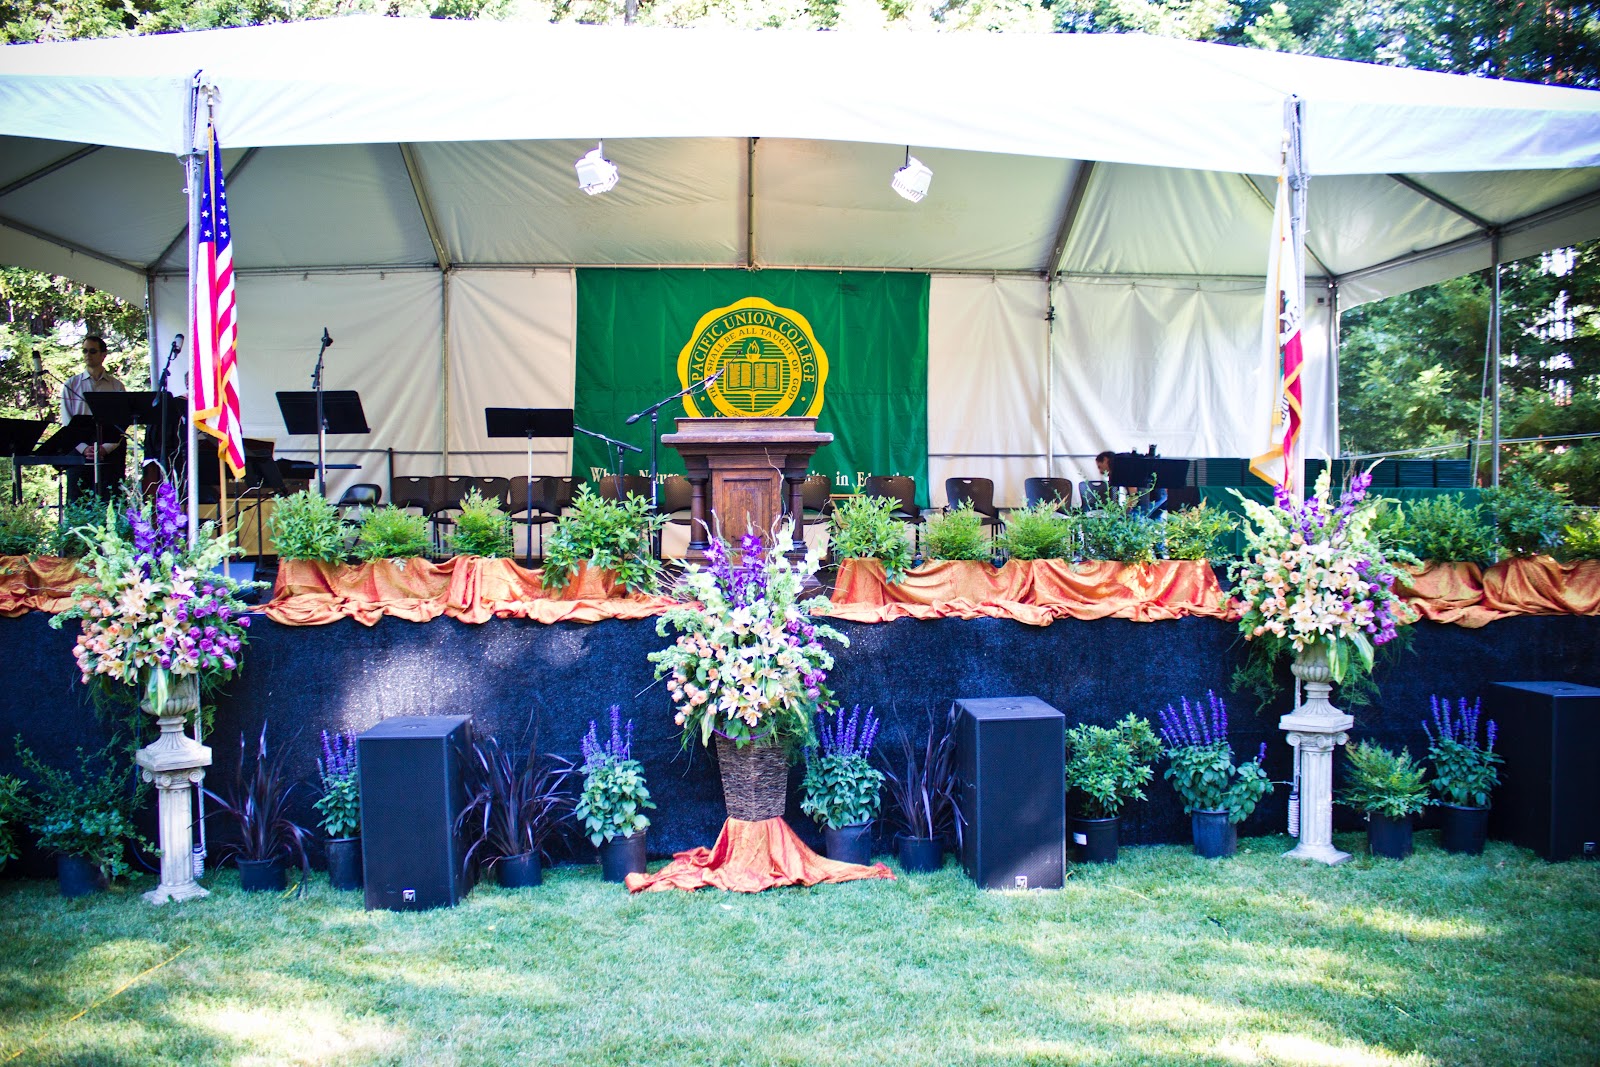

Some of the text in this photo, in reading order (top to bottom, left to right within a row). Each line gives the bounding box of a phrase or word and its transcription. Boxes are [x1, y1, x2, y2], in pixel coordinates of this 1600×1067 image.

[724, 332, 736, 343] BE
[739, 328, 757, 337] ALL
[691, 312, 814, 382] PACIFIC UNION COLLEGE
[759, 328, 794, 356] TAUGHT
[707, 343, 724, 371] SHALL
[791, 359, 799, 373] OF
[788, 378, 799, 400] GOD
[835, 471, 849, 486] in
